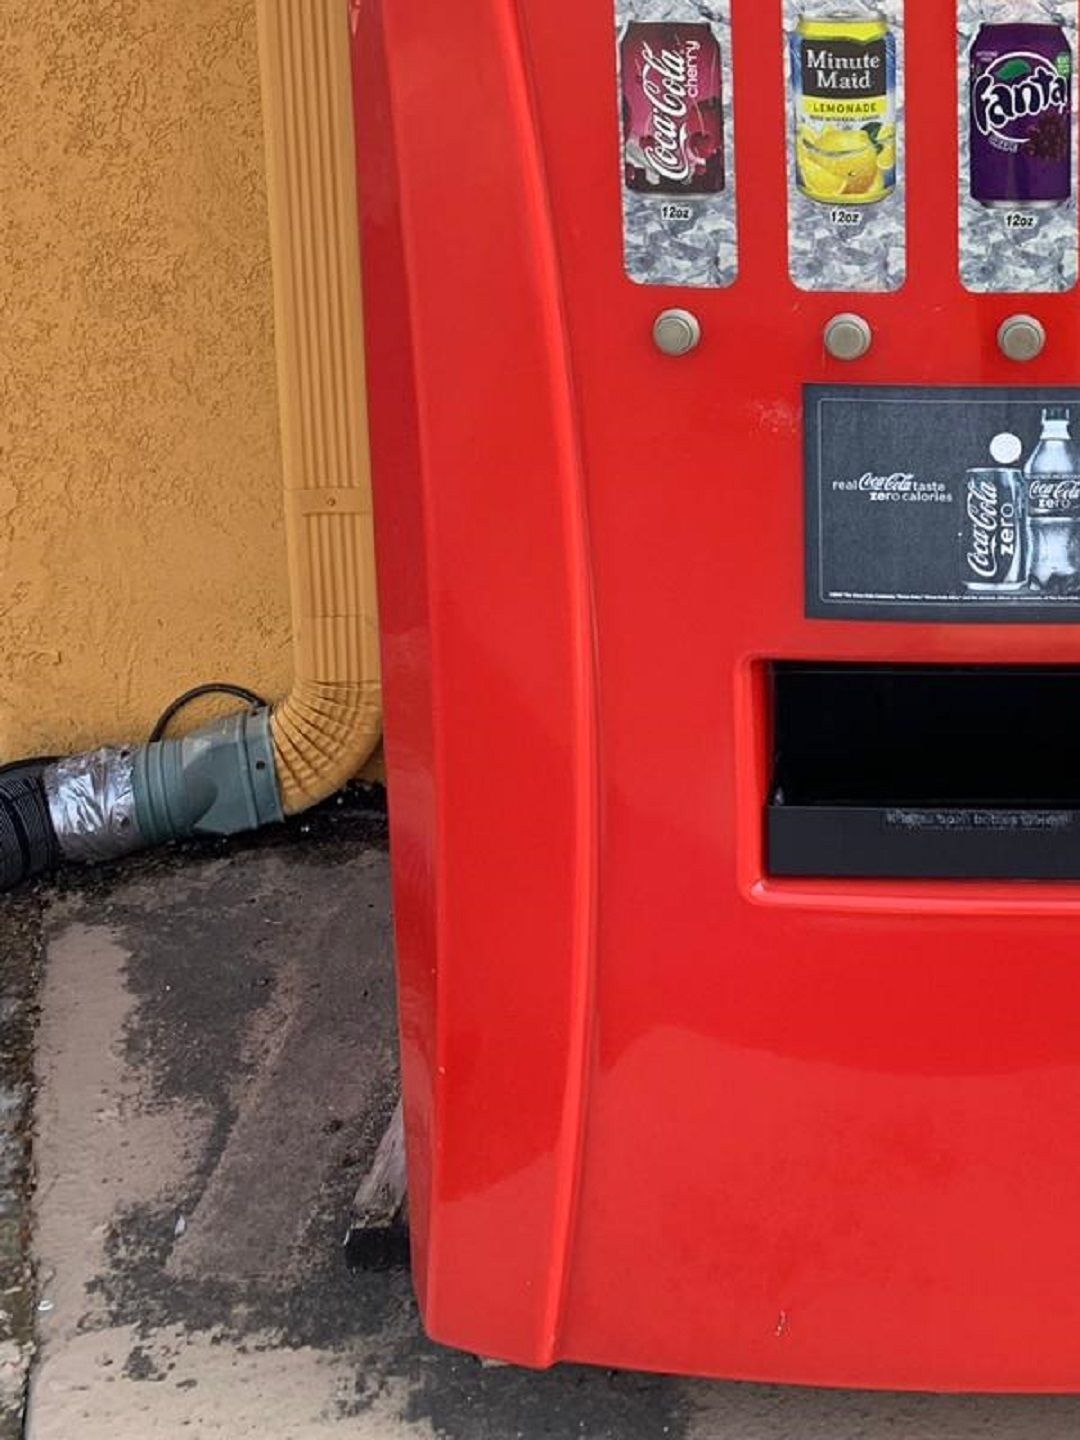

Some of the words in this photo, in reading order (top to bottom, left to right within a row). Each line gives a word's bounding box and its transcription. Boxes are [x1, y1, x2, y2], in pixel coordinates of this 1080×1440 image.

[684, 40, 700, 98] cherry
[806, 49, 881, 69] Minute
[816, 69, 871, 89] Maid
[641, 40, 689, 180] Coca-Cola
[813, 102, 878, 114] LEMONADE
[972, 65, 1068, 136] Fanta
[832, 480, 858, 491] real
[913, 481, 946, 492] taste
[870, 492, 900, 502] zero
[902, 491, 953, 503] calories
[1038, 499, 1071, 509] zero
[1000, 502, 1014, 556] zero
